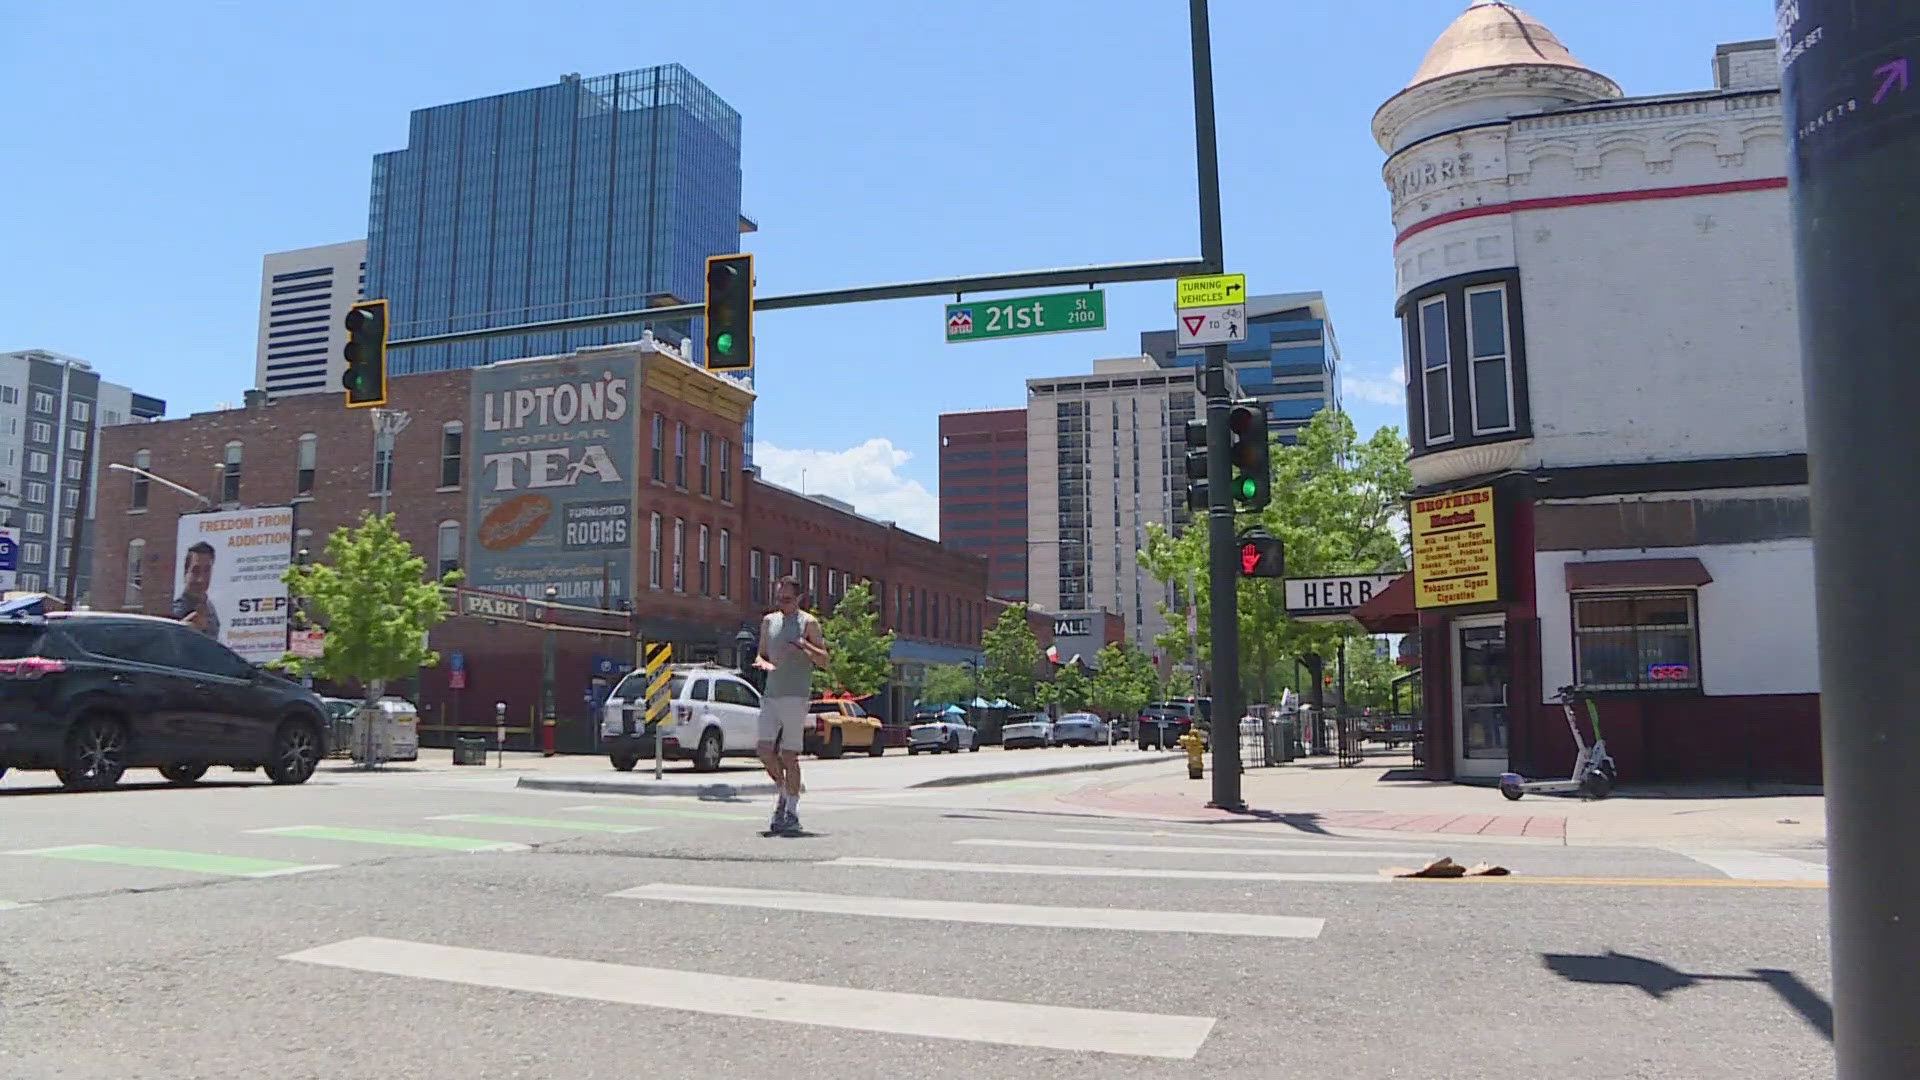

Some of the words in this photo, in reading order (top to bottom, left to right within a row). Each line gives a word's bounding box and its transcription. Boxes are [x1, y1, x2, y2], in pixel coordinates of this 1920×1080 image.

[1799, 99, 1856, 139] TICKETS
[1183, 281, 1222, 291] TURNING
[1075, 298, 1087, 310] St
[1181, 293, 1223, 303] VEHICLES
[985, 302, 1044, 332] 21st
[1068, 311, 1096, 324] 2100
[1209, 320, 1220, 329] TO
[484, 370, 627, 432] LIPTON'S
[502, 428, 610, 447] POPULAR
[483, 445, 624, 492] TEA
[569, 505, 626, 519] FURNISHED
[1416, 491, 1490, 514] BROTHERS
[199, 516, 254, 533] FREEDOM
[258, 513, 291, 528] FROM
[567, 519, 627, 545] ROOMS
[228, 531, 291, 548] ADDICTION
[592, 578, 621, 598] MN
[1304, 575, 1398, 607] HERB'
[1423, 583, 1454, 593] Tobacco
[1464, 579, 1489, 590] Cigars
[239, 597, 286, 613] STEP
[468, 596, 519, 618] PARK
[1437, 591, 1475, 604] Cigarettes
